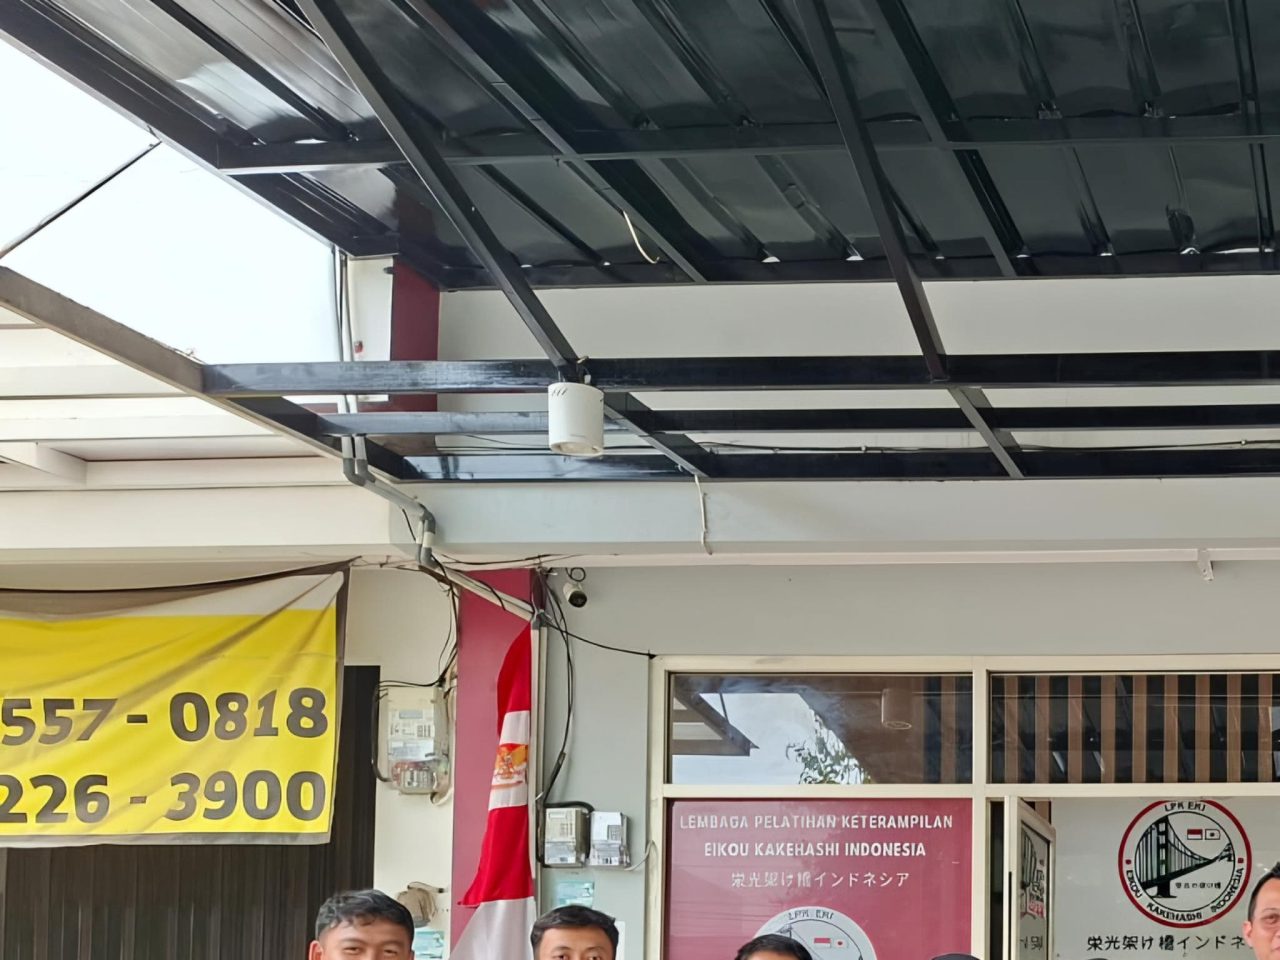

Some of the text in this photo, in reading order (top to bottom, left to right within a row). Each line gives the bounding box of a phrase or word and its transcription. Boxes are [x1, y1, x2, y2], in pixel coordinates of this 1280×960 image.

[1, 698, 118, 746] 557
[169, 687, 328, 742] 0818
[0, 774, 110, 824] 226
[163, 770, 326, 821] 3900
[680, 814, 953, 829] LEMBAGA PELATIHAN KETERAMPILAN
[704, 842, 926, 857] EIKOU KAKEHASHI INDONESIA
